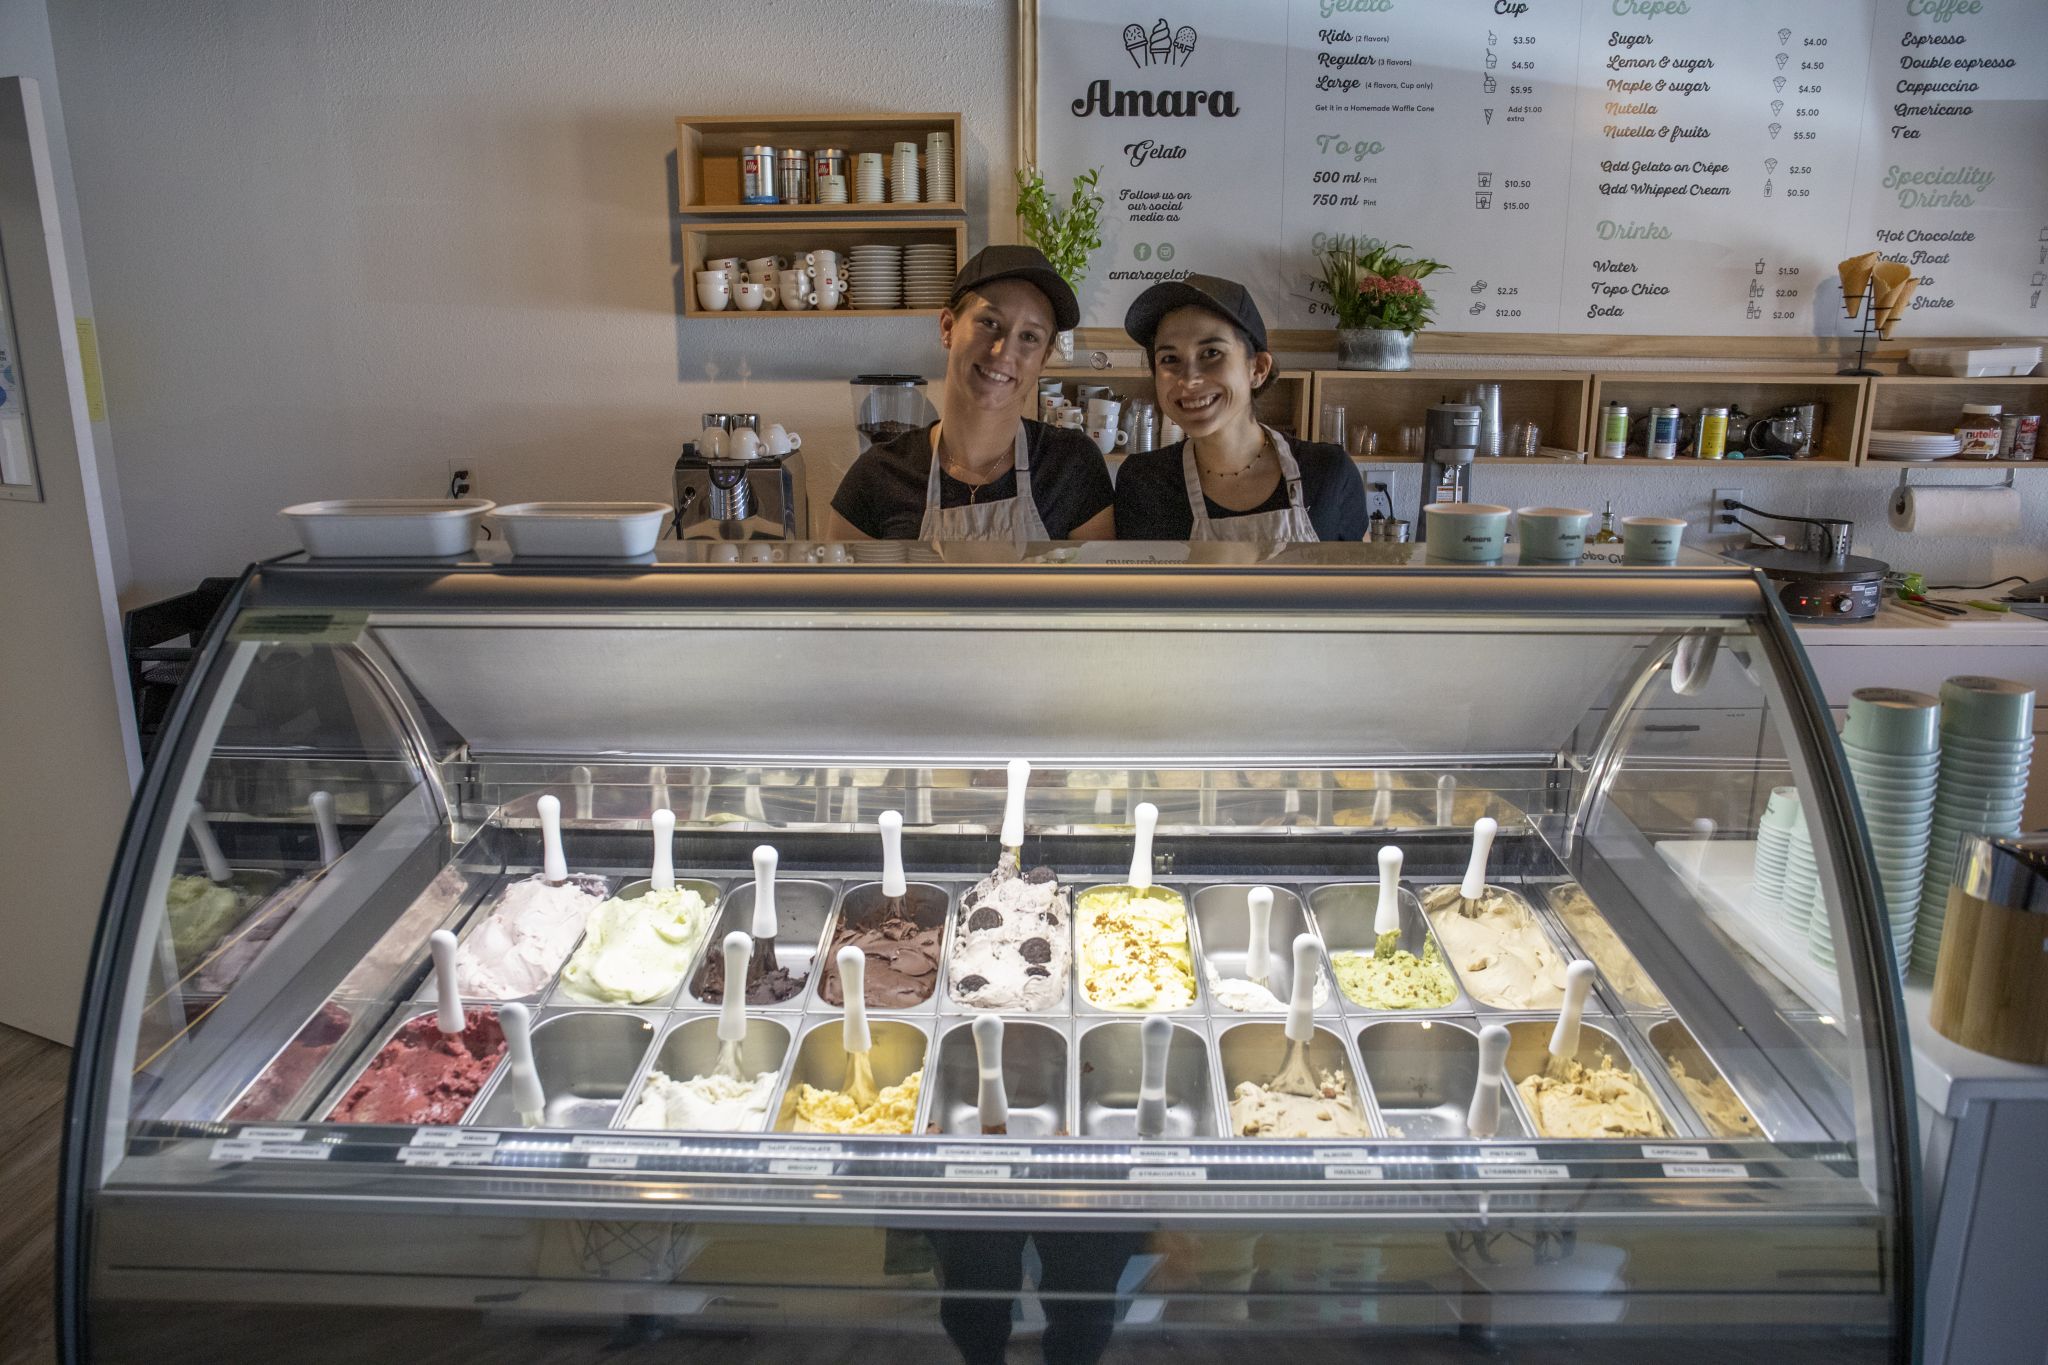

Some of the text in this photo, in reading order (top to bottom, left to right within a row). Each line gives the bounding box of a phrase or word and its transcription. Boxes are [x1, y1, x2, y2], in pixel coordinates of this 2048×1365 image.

[1319, 0, 1394, 19] Gelato
[1494, 0, 1529, 18] Cup
[1907, 0, 1983, 23] Coffee
[1318, 29, 1390, 45] Kids (2 flavors)
[1513, 36, 1536, 45] $3.50
[1608, 31, 1653, 49] Sugar
[1803, 37, 1828, 47] $4.00
[1901, 32, 1967, 48] Espresso
[1317, 52, 1412, 70] Regular (3 flavors)
[1511, 61, 1535, 70] $4.50
[1606, 55, 1714, 73] Lemon & sugar
[1801, 61, 1825, 70] $4.50
[1900, 56, 2017, 72] Double espresso
[1315, 75, 1433, 93] Large (4 flavors, Cup only)
[1510, 86, 1533, 94] $5.95
[1606, 79, 1711, 96] Maple & sugar
[1798, 85, 1822, 94] $4.50
[1896, 79, 1980, 95] Cappuccino
[1071, 79, 1240, 118] Amara
[1315, 104, 1328, 112] Get
[1329, 104, 1335, 112] it
[1335, 104, 1342, 112] in
[1350, 104, 1390, 112] Homemade
[1392, 104, 1415, 112] Waffle
[1524, 106, 1543, 114] $1.00
[1605, 102, 1658, 116] Nutella
[1796, 108, 1820, 117] $5.00
[1894, 103, 1973, 117] Americano
[1603, 125, 1711, 143] Nutella & fruits
[1793, 132, 1817, 141] $5.50
[1891, 125, 1921, 139] Tea
[1124, 139, 1187, 168] Gelato
[1316, 134, 1385, 162] To go
[746, 161, 758, 173] illy
[1600, 160, 1730, 176] Add Gelato on Crêpe
[1789, 166, 1812, 175] $2.50
[1312, 171, 1378, 184] 500 ml Pint
[1504, 180, 1531, 189] $10.50
[1882, 165, 1996, 193] Speciality
[1119, 189, 1192, 201] Follow us on
[1599, 182, 1731, 198] Add Whipped Cream
[1786, 189, 1810, 198] $0.50
[1128, 201, 1183, 211] our social
[1312, 194, 1377, 207] 750 ml Pint
[1898, 188, 1976, 210] Drinks
[1503, 202, 1530, 211] $15.00
[1130, 212, 1181, 222] media as
[1596, 220, 1673, 241] Drinks
[1876, 229, 1977, 243] Hot Chocolate
[1910, 250, 1950, 265] Float
[1593, 260, 1639, 273] Water
[1778, 267, 1800, 276] $1.50
[1497, 287, 1518, 295] $2.25
[1591, 281, 1670, 298] Topo Chico
[1775, 289, 1798, 298] $2.00
[1308, 303, 1318, 314] 6
[1912, 295, 1955, 310] Shake
[1495, 309, 1522, 318] $12.00
[1587, 304, 1624, 319] Soda
[1773, 311, 1795, 320] $2.00
